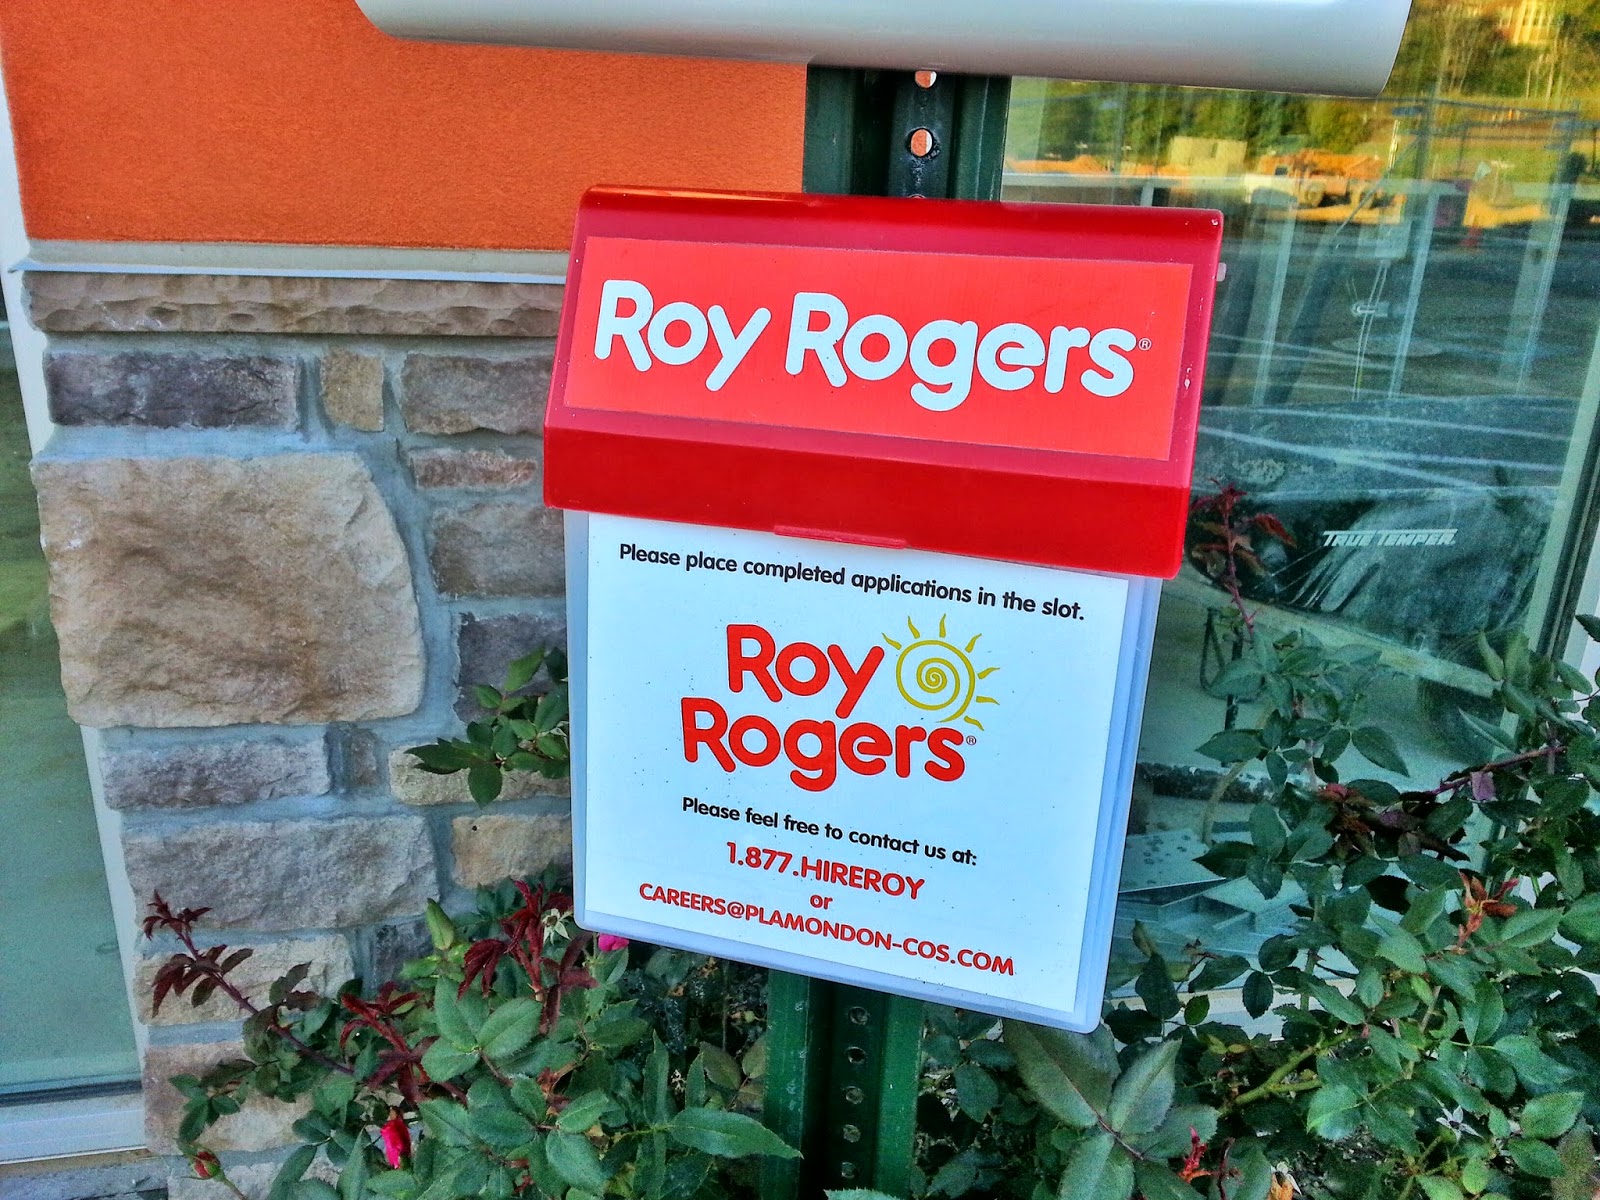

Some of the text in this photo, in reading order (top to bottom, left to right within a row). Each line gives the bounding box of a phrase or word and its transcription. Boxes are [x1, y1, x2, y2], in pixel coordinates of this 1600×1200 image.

[594, 279, 772, 392] Roy
[619, 543, 1085, 621] Please place completed applications in the slot.
[725, 623, 885, 719] Roy
[682, 797, 977, 867] Please feel free to contact us at:
[726, 842, 925, 900] 1.877.HIREROY
[638, 883, 1015, 976] CAREERS@PLAMONDON-COS.COM
[809, 894, 834, 910] or
